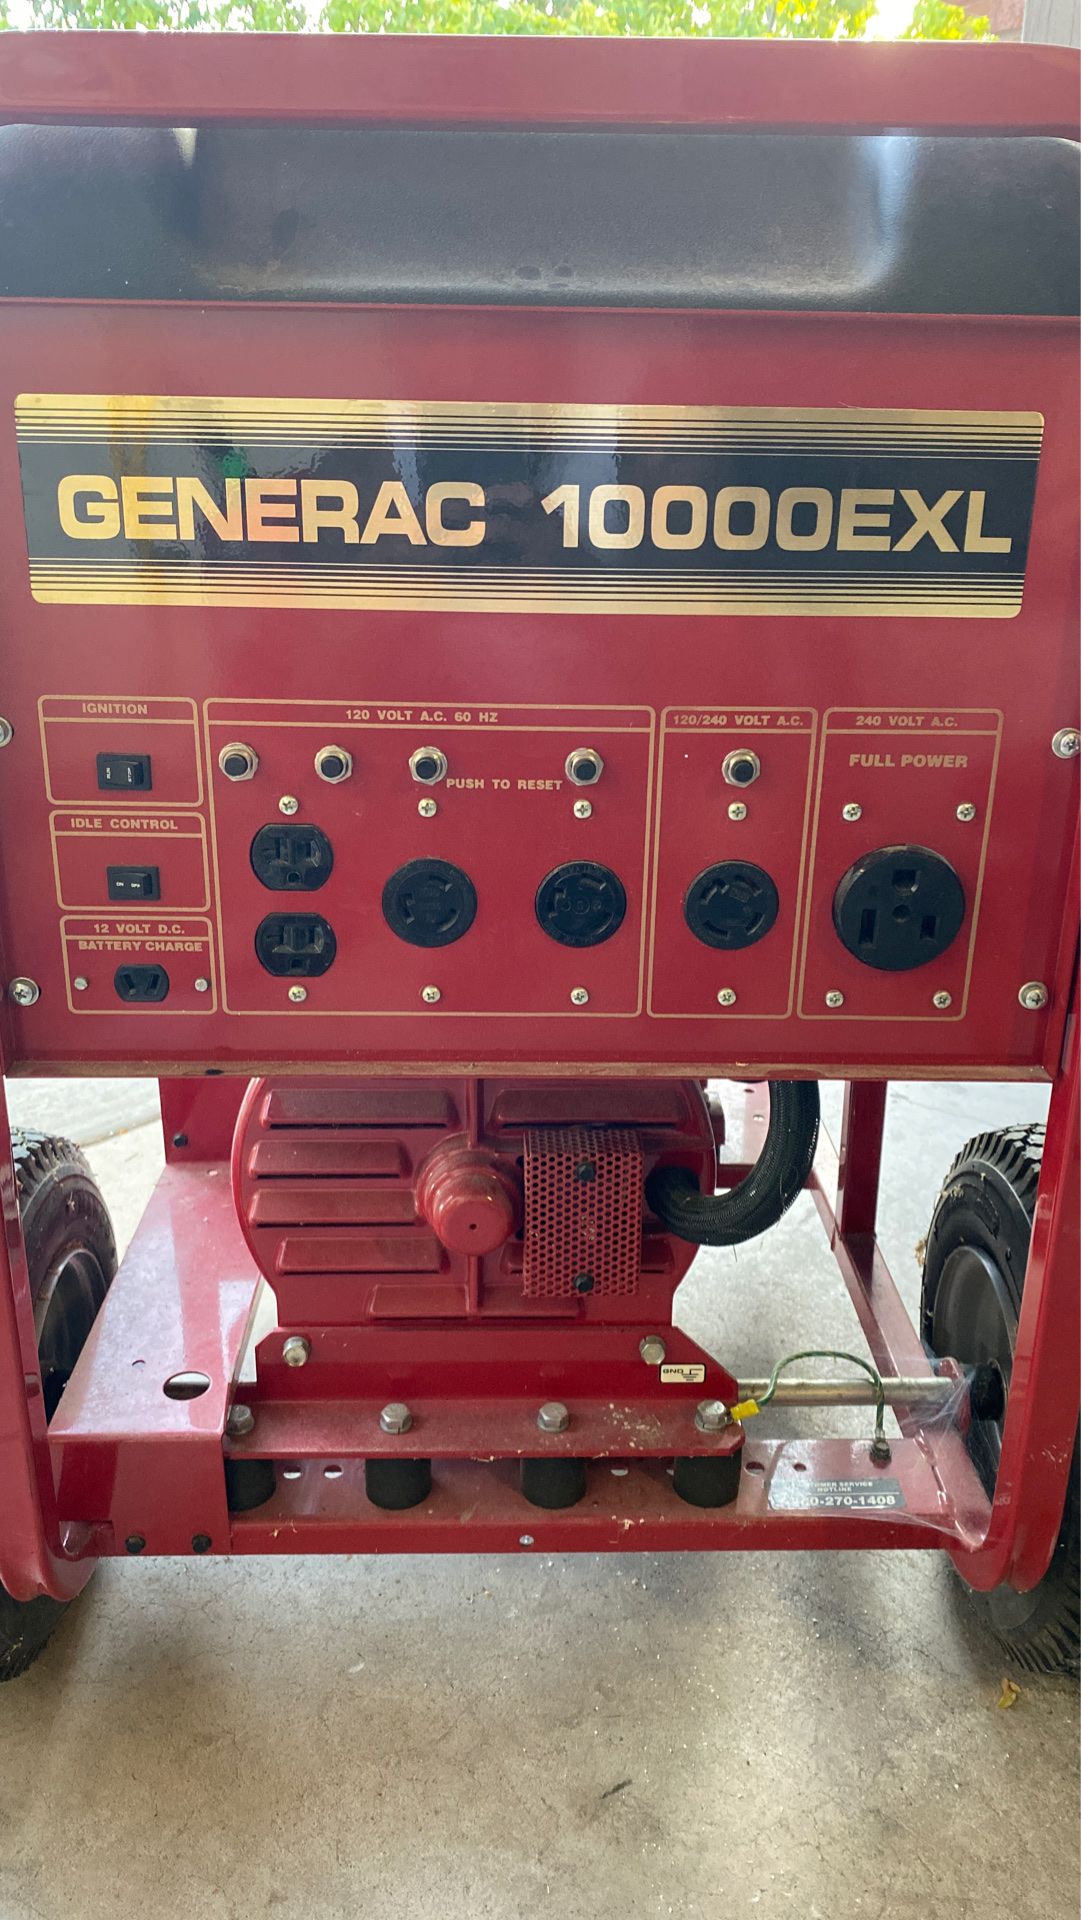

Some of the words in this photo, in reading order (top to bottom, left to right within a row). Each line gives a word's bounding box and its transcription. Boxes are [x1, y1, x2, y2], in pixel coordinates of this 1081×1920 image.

[57, 474, 487, 548] GENERAC
[540, 484, 1013, 554] 10000EXL
[82, 703, 148, 715] IGNITION
[345, 709, 370, 721] 120
[377, 709, 413, 721] VOLT
[420, 710, 447, 722] A.C.
[454, 711, 472, 723] 60
[478, 711, 499, 723] HZ
[673, 714, 728, 727] 120/240
[734, 714, 771, 726] VOLT
[777, 715, 804, 727] A.C.
[855, 715, 882, 727] 240
[888, 715, 925, 727] VOLT
[931, 716, 958, 727] A.C.
[849, 753, 896, 768] FULL
[900, 754, 968, 768] POWER
[446, 778, 485, 790] PUSH
[491, 778, 511, 790] TO
[517, 779, 563, 791] RESET
[70, 818, 103, 829] IDLE
[109, 818, 178, 831] CONTROL
[93, 923, 110, 934] 12
[115, 923, 151, 934] VOLT
[158, 923, 185, 935] D.C.
[78, 939, 142, 952] BATTERY
[145, 940, 203, 953] CHARGE
[780, 1494, 896, 1507] 0-270-1408
